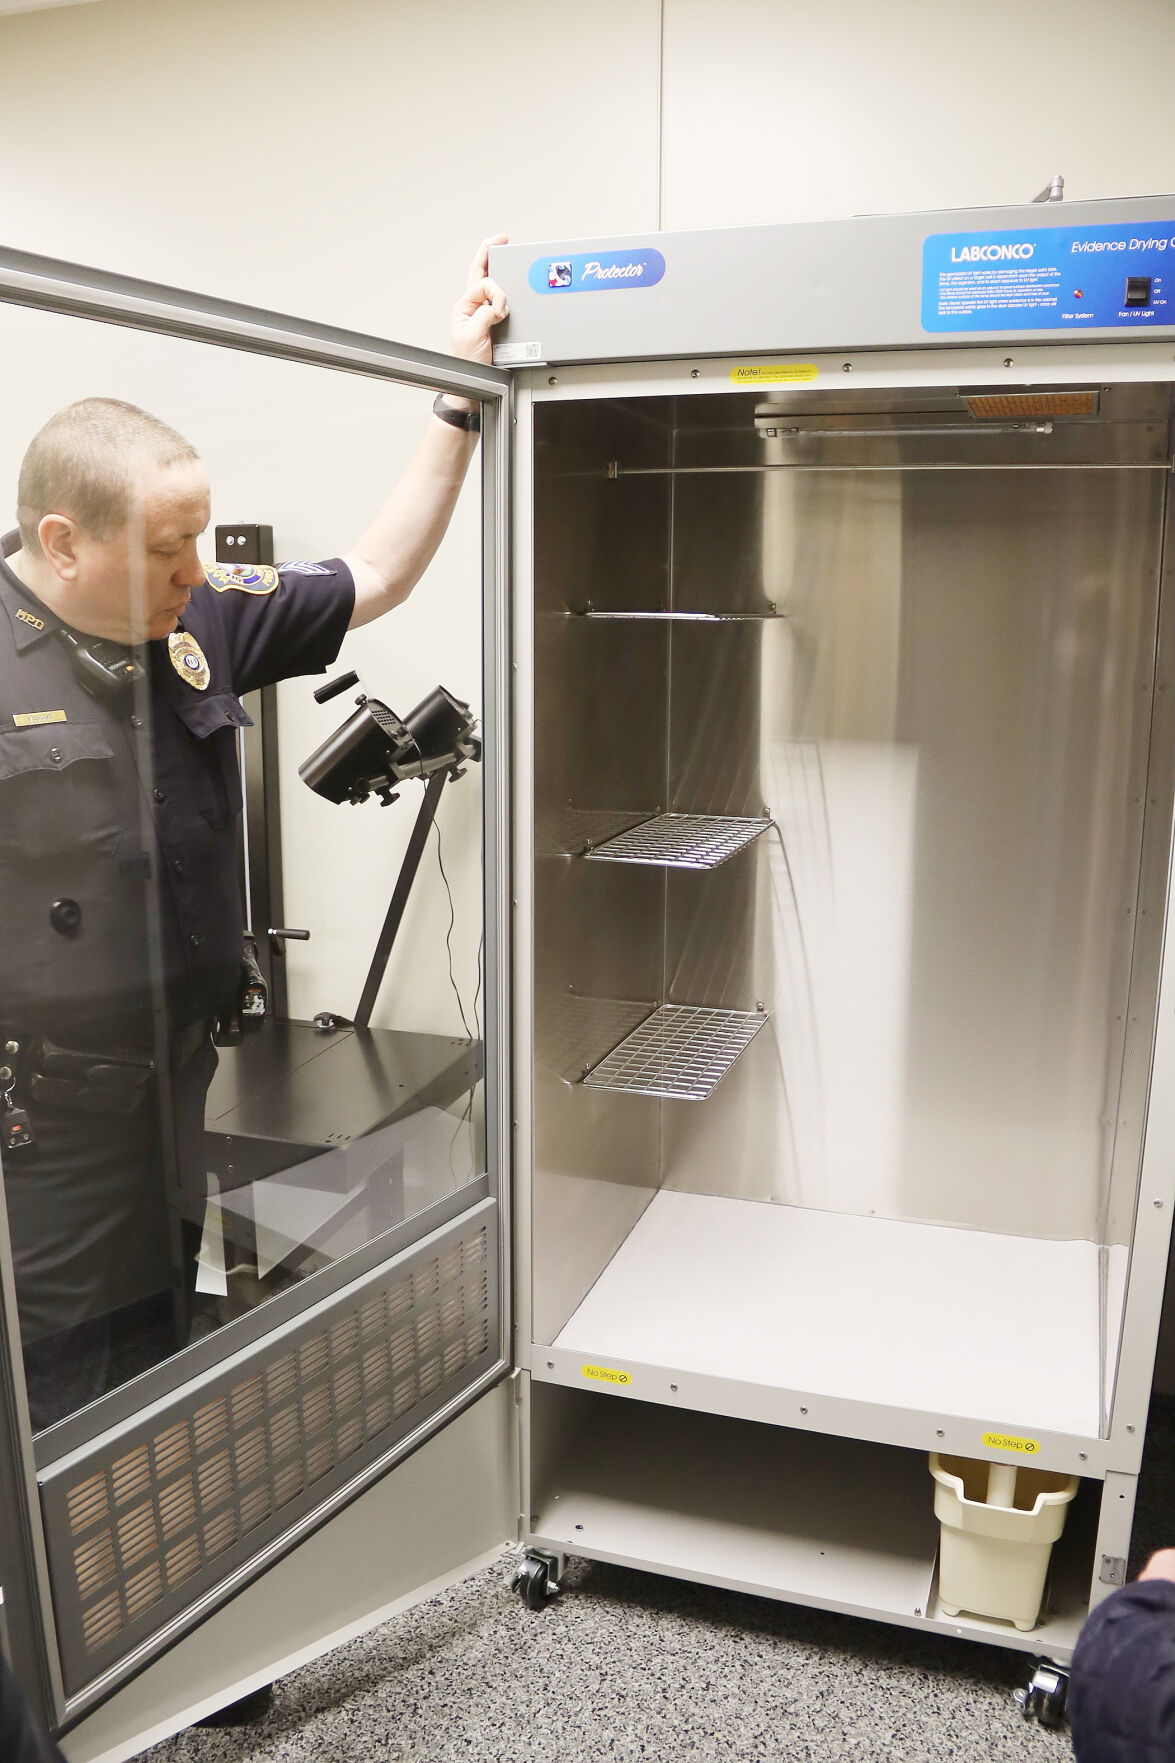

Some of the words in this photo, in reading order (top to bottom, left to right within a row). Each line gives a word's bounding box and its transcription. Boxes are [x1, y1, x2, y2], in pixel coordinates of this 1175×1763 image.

[1071, 240, 1126, 253] Evidence
[1129, 237, 1169, 252] Drying
[951, 243, 1035, 263] LABCONCO
[581, 261, 644, 282] Protector
[1141, 310, 1155, 318] Light
[737, 368, 761, 376] Note!
[587, 1368, 598, 1376] No
[600, 1370, 617, 1381] Step
[988, 1436, 1001, 1445] No
[1003, 1438, 1023, 1450] Step
